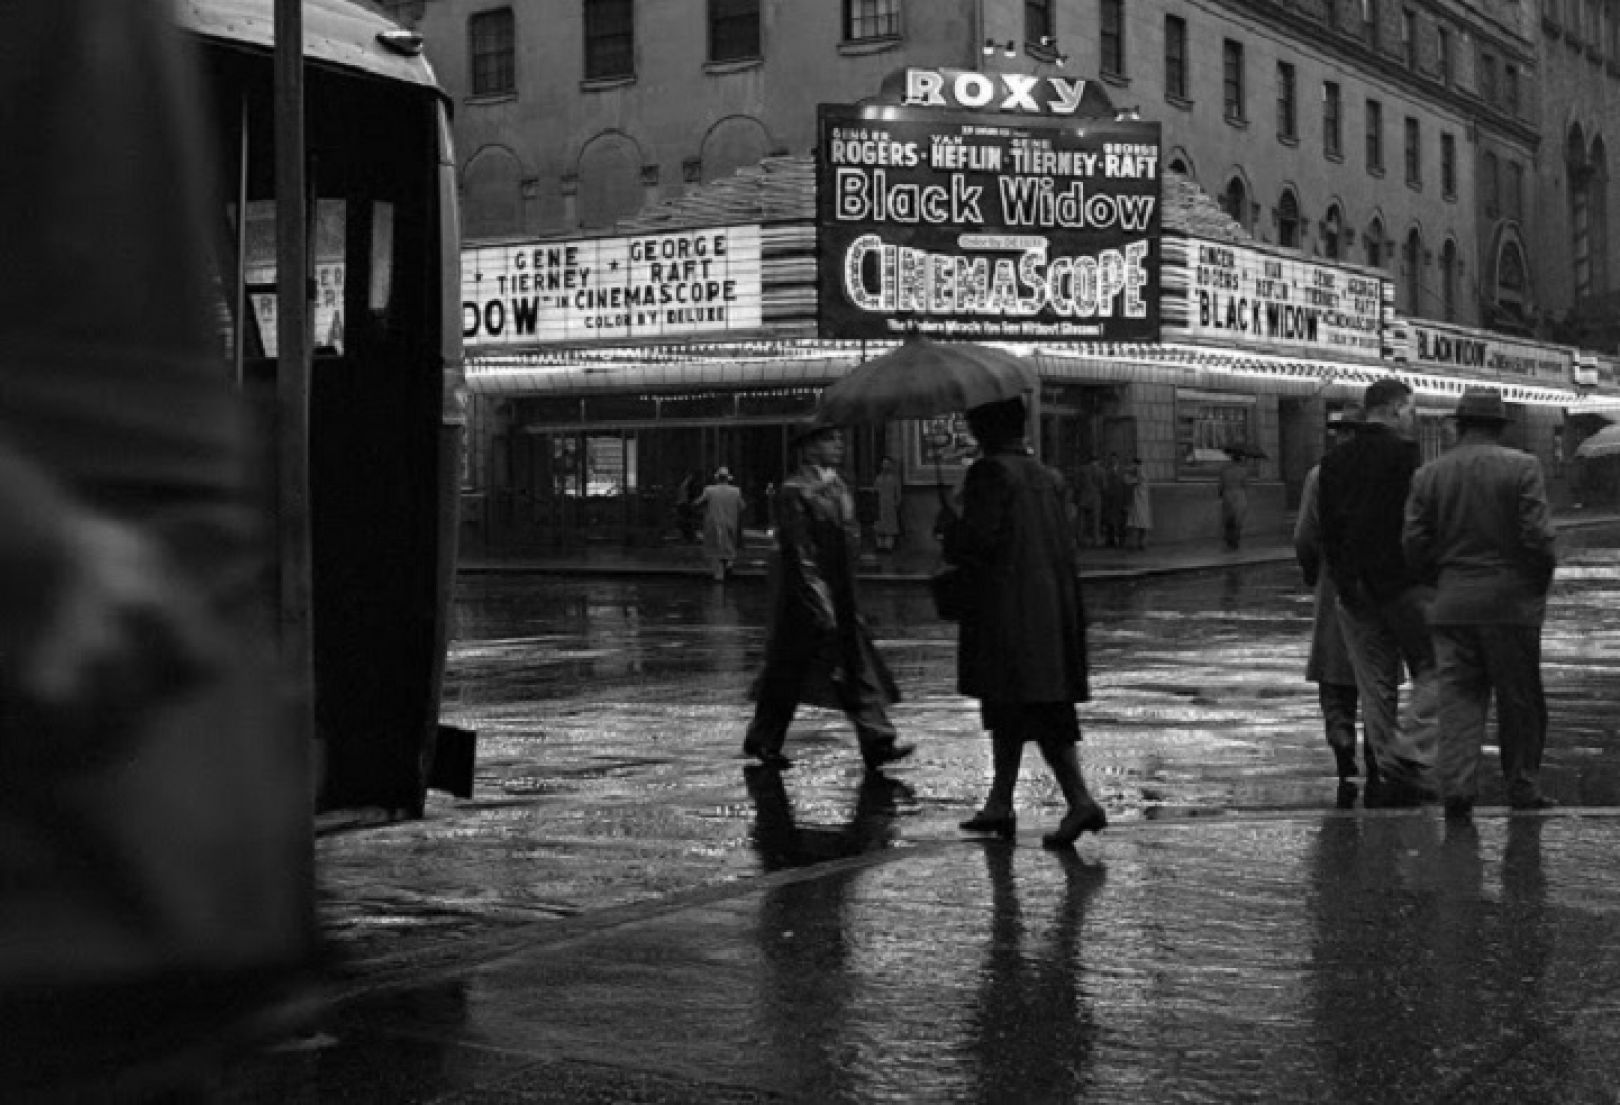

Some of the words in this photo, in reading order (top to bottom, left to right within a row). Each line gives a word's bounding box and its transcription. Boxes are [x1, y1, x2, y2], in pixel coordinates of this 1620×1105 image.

[905, 68, 1086, 112] ROXY
[831, 139, 918, 166] ROGERS
[931, 145, 1001, 171] HEFLIN
[1011, 149, 1097, 176] TIERNEY
[1104, 154, 1157, 179] RAFT
[836, 167, 984, 223] Black
[999, 176, 1156, 230] Widow
[514, 247, 578, 270] GENE
[630, 235, 726, 261] GEORGE
[497, 267, 590, 295] TIERNEY
[651, 258, 713, 283] RAFT
[575, 280, 736, 310] CINEMASCOPE
[1200, 290, 1261, 335] BLACK
[1265, 301, 1318, 341] WIDOW
